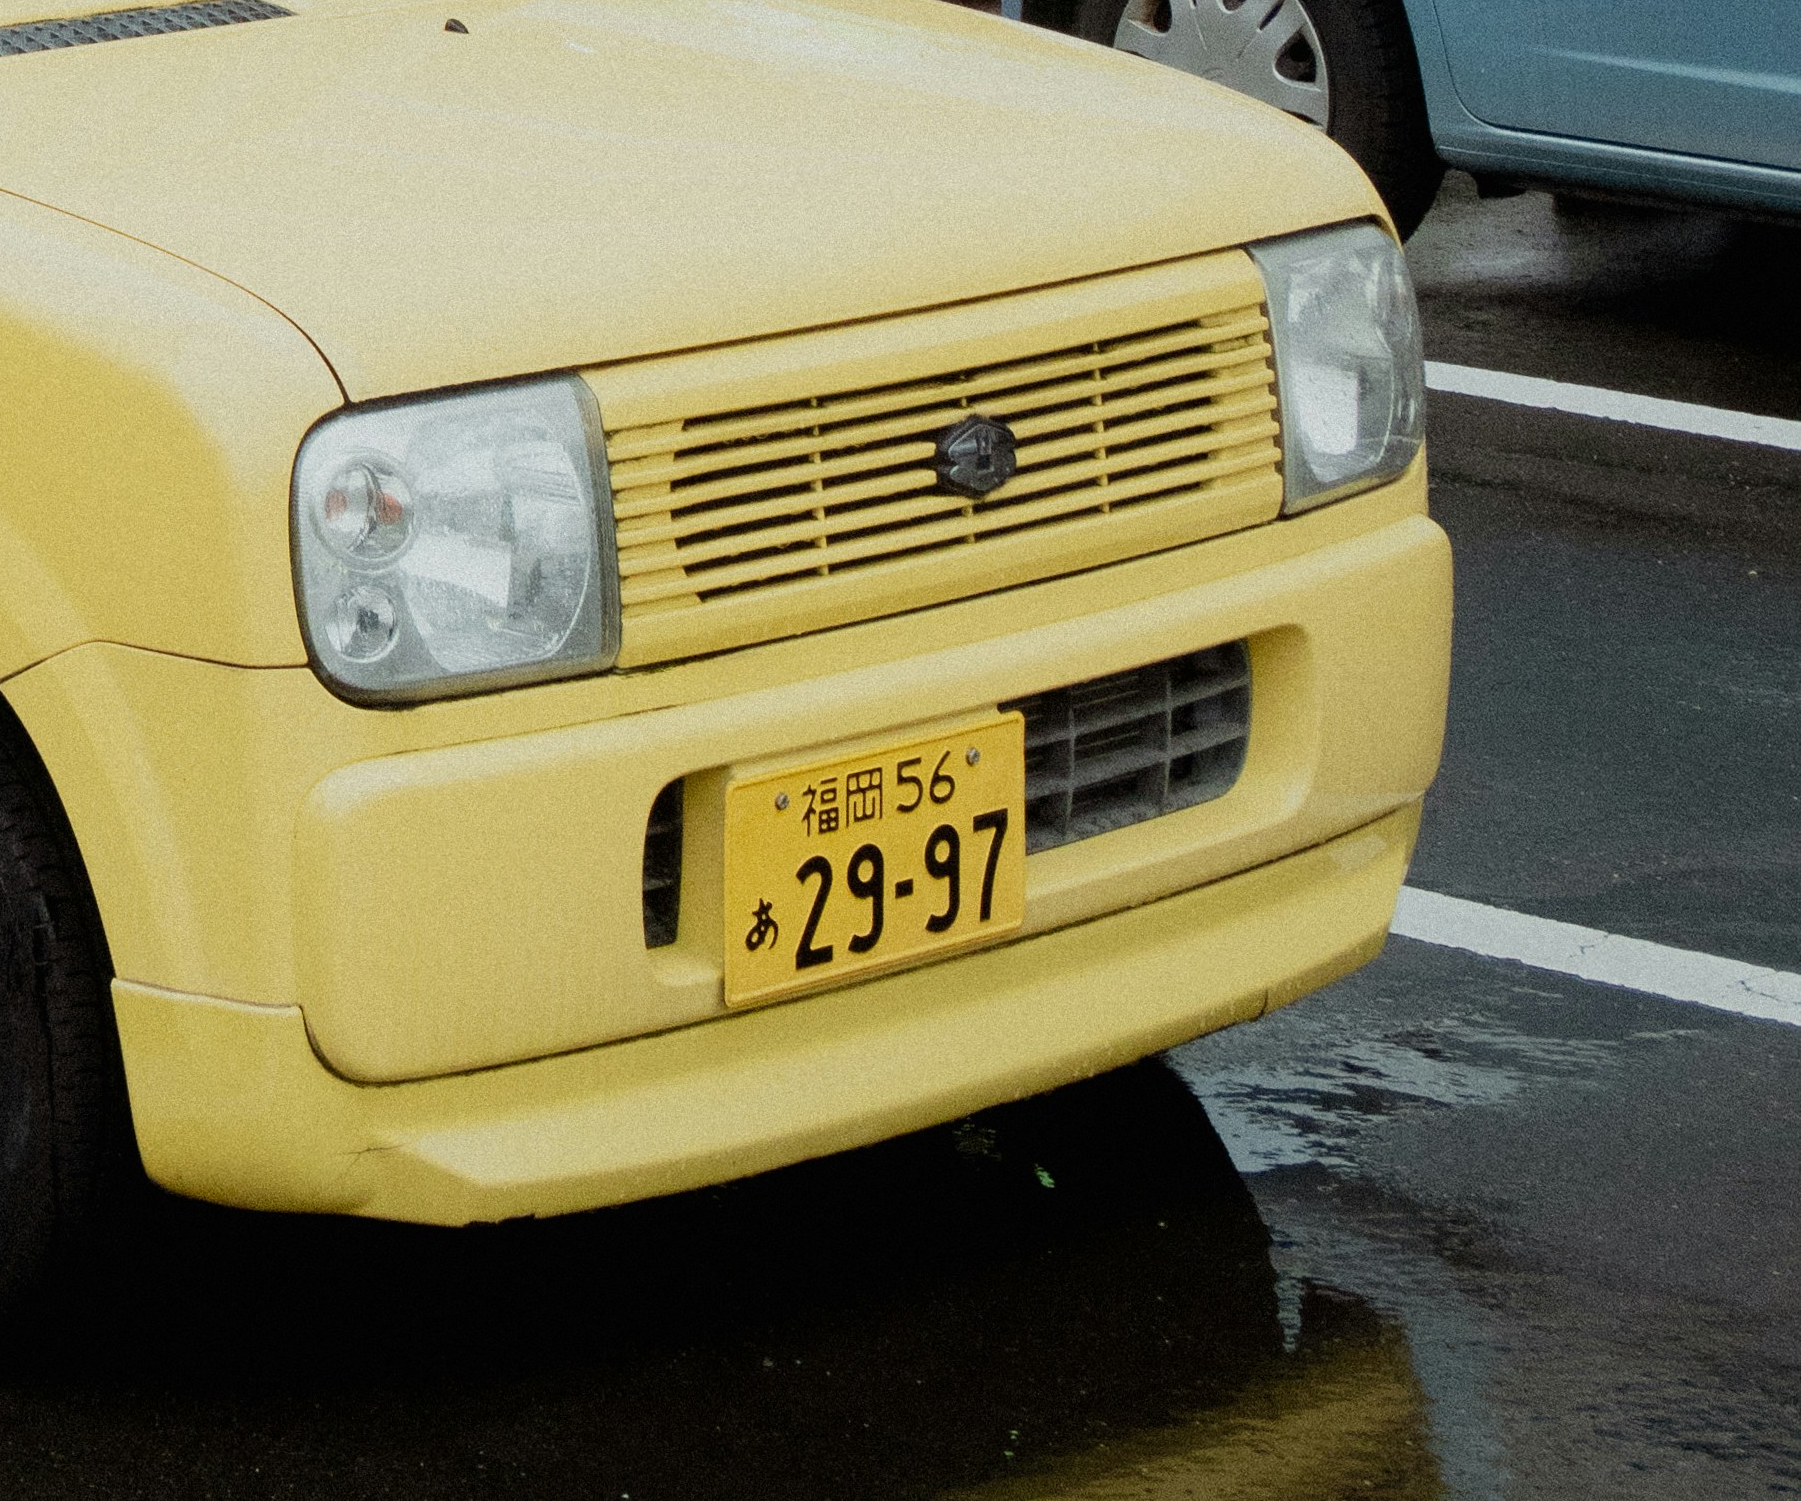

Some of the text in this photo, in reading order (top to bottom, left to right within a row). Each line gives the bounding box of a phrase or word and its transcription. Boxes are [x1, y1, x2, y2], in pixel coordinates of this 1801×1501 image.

[801, 750, 956, 837] 福岡 56
[745, 808, 1009, 971] あ 29-97
